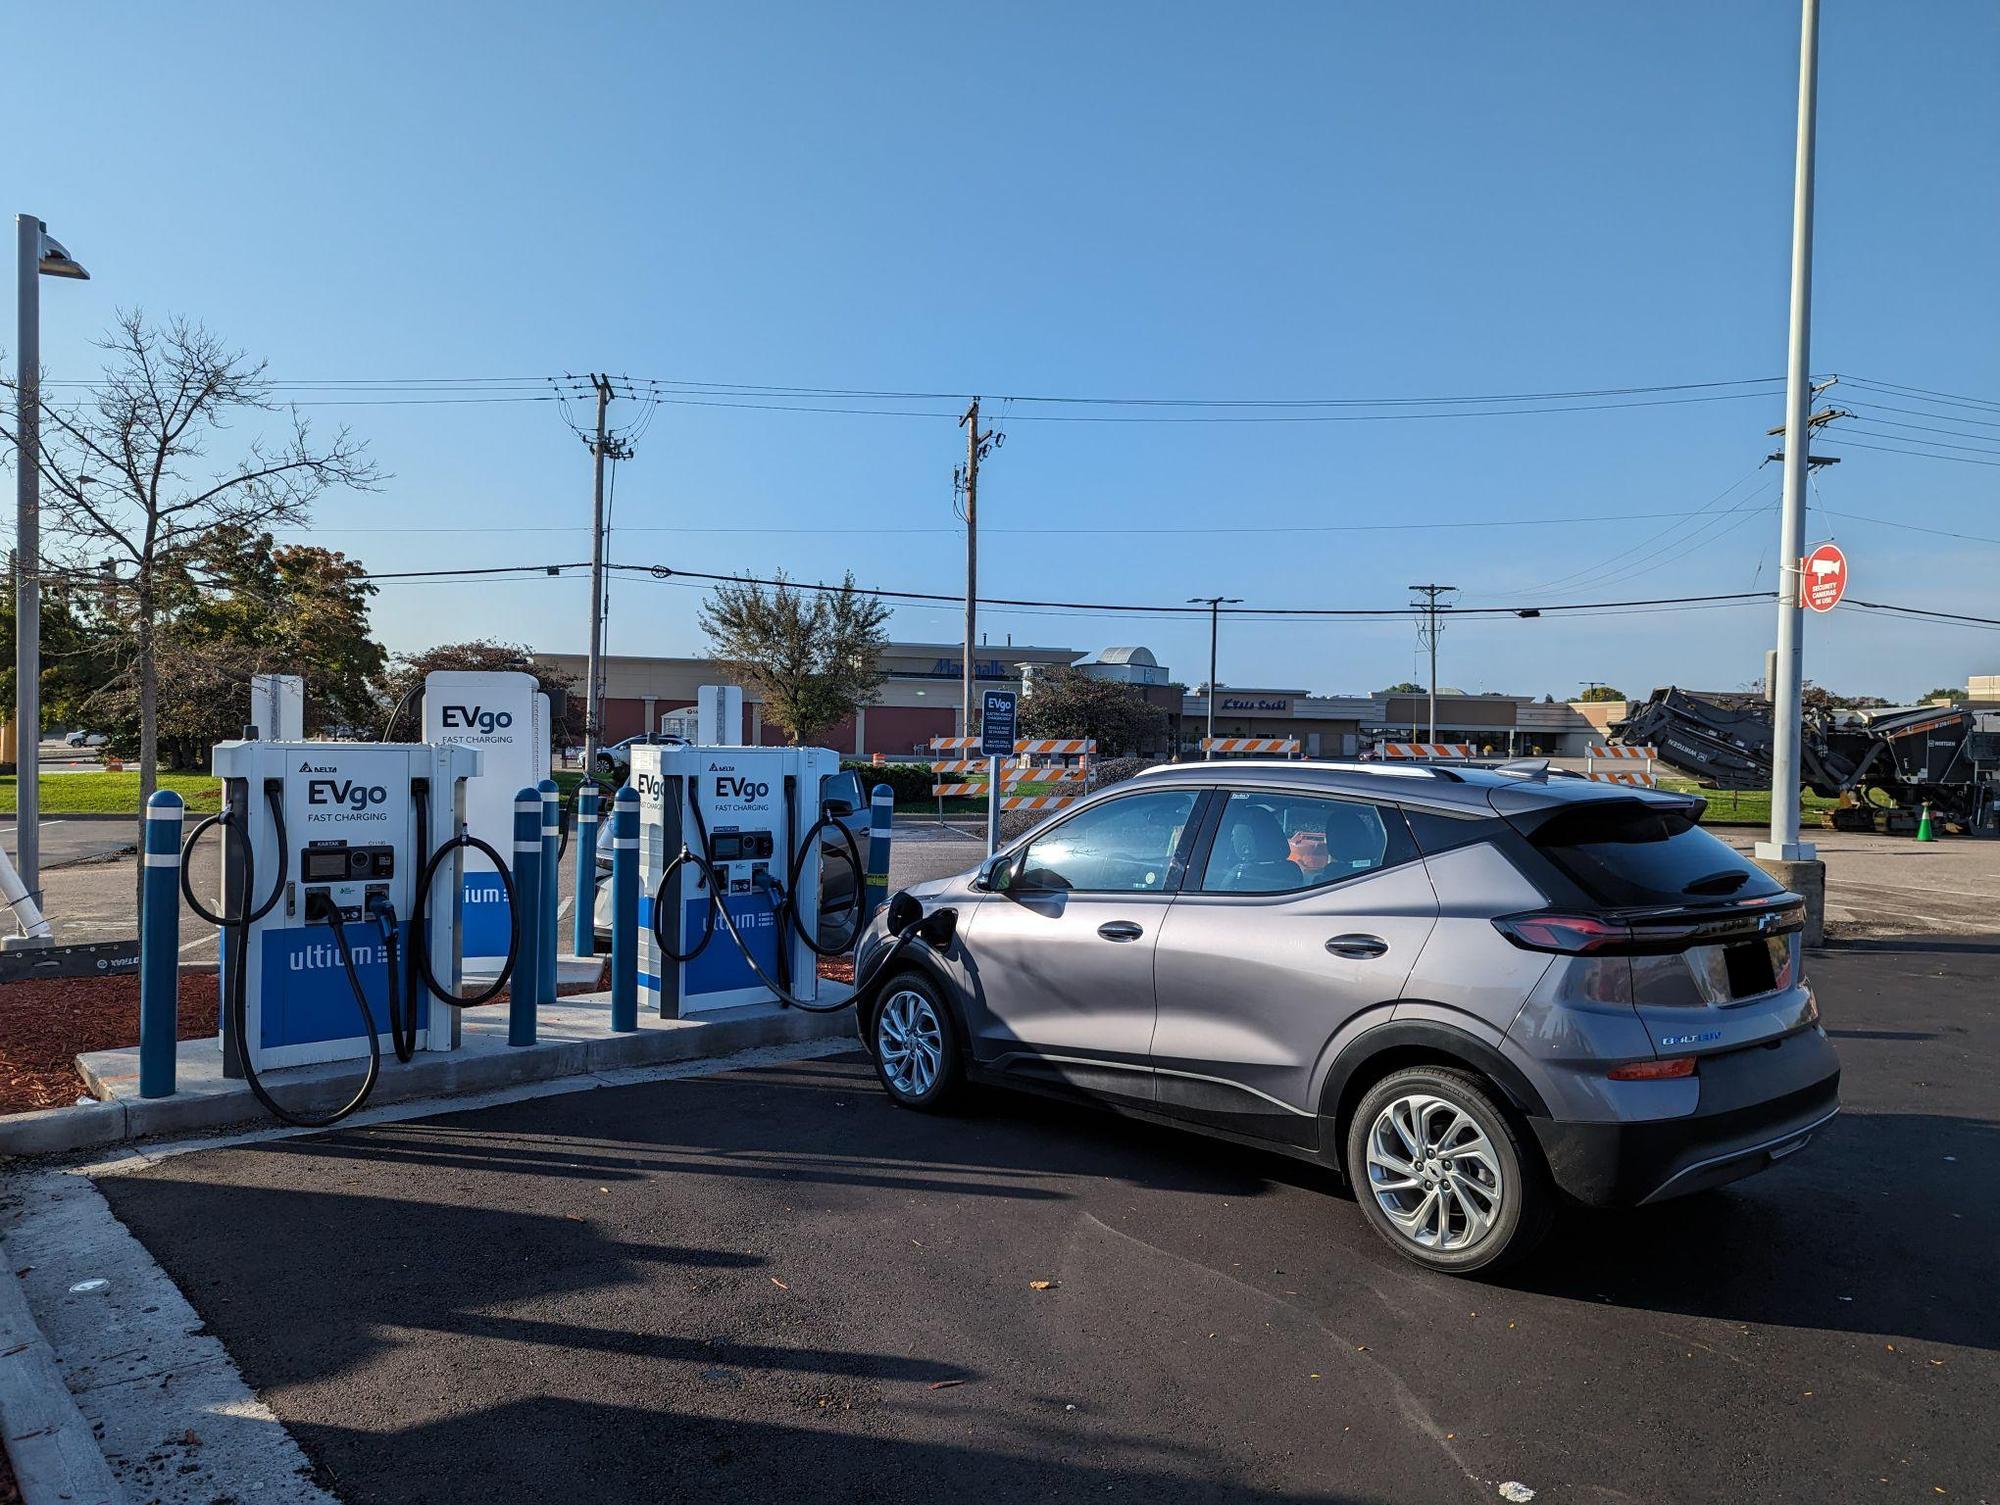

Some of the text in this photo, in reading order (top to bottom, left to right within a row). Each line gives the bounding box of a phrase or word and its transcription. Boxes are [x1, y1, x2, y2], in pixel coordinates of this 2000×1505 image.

[988, 698, 1012, 712] EVgo
[442, 706, 512, 734] EVgo
[466, 736, 513, 744] CHARGING
[308, 780, 388, 810] EVgo
[716, 777, 769, 802] EVgo
[308, 812, 387, 822] FAST CHARGING
[463, 886, 499, 903] ium
[703, 912, 754, 932] ultum
